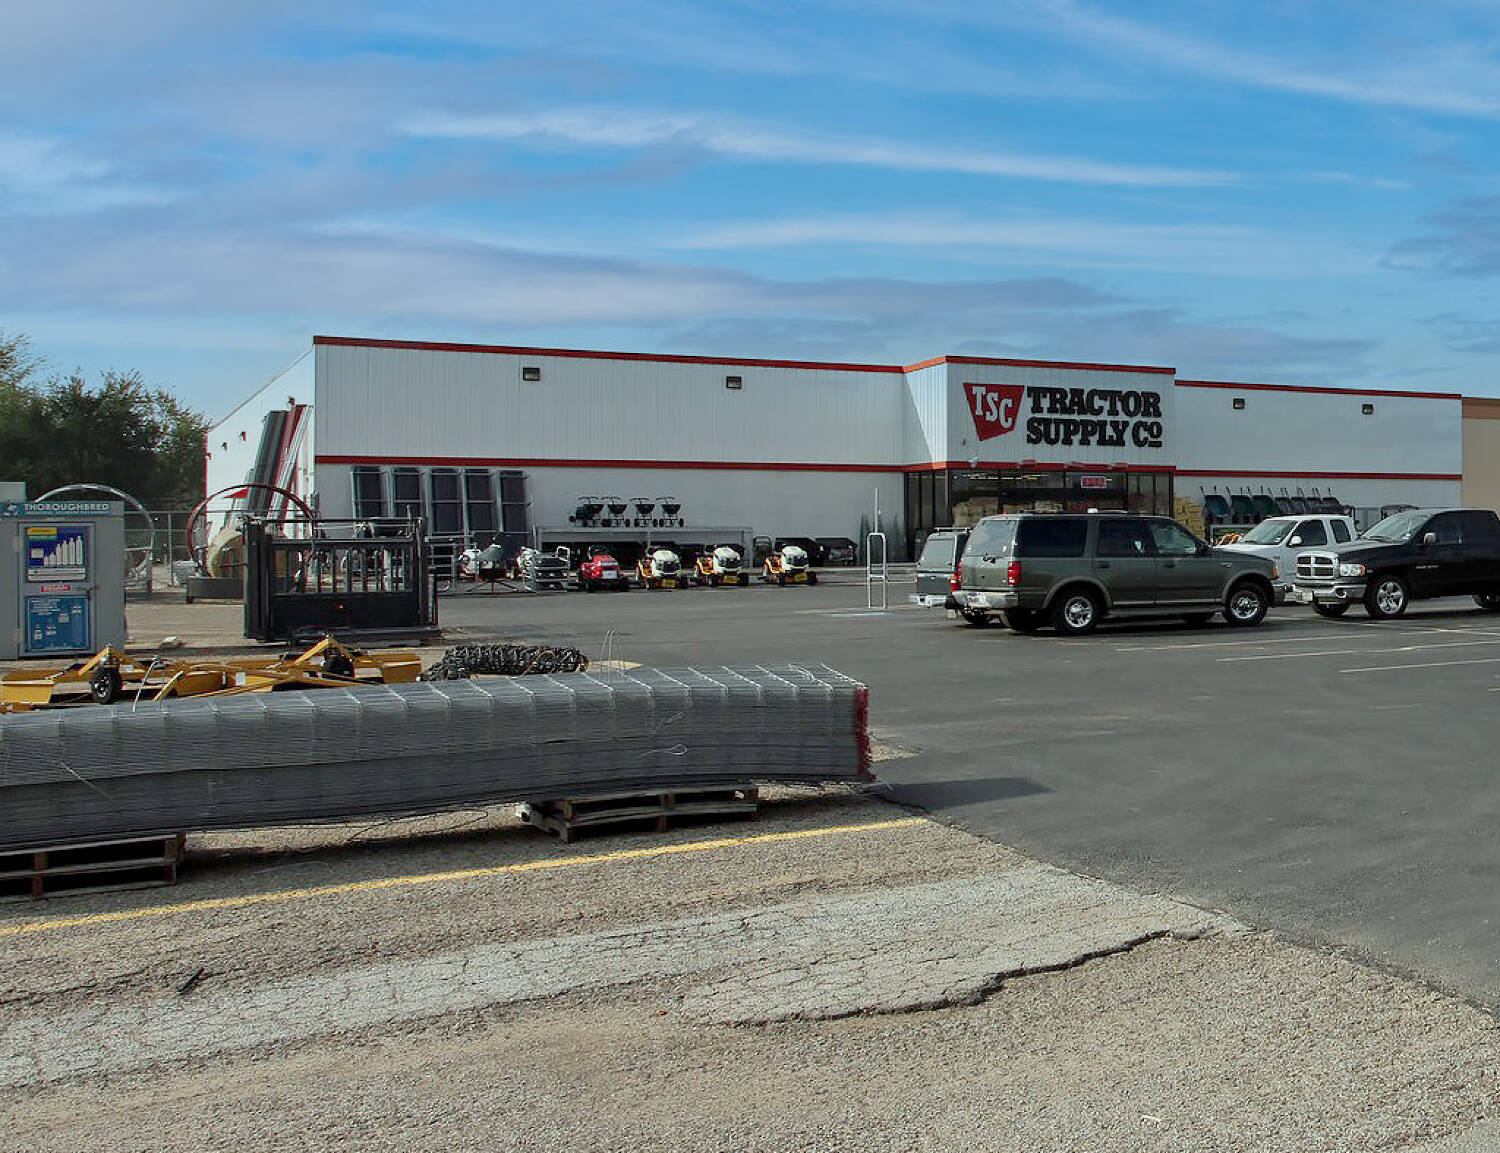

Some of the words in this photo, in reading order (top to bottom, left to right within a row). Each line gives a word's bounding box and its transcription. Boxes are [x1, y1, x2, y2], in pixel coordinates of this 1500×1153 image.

[972, 382, 1013, 429] TSC
[1026, 386, 1163, 418] TRACTOR
[1026, 417, 1130, 447] SUPPLY
[24, 503, 110, 511] THOROUGHBRED
